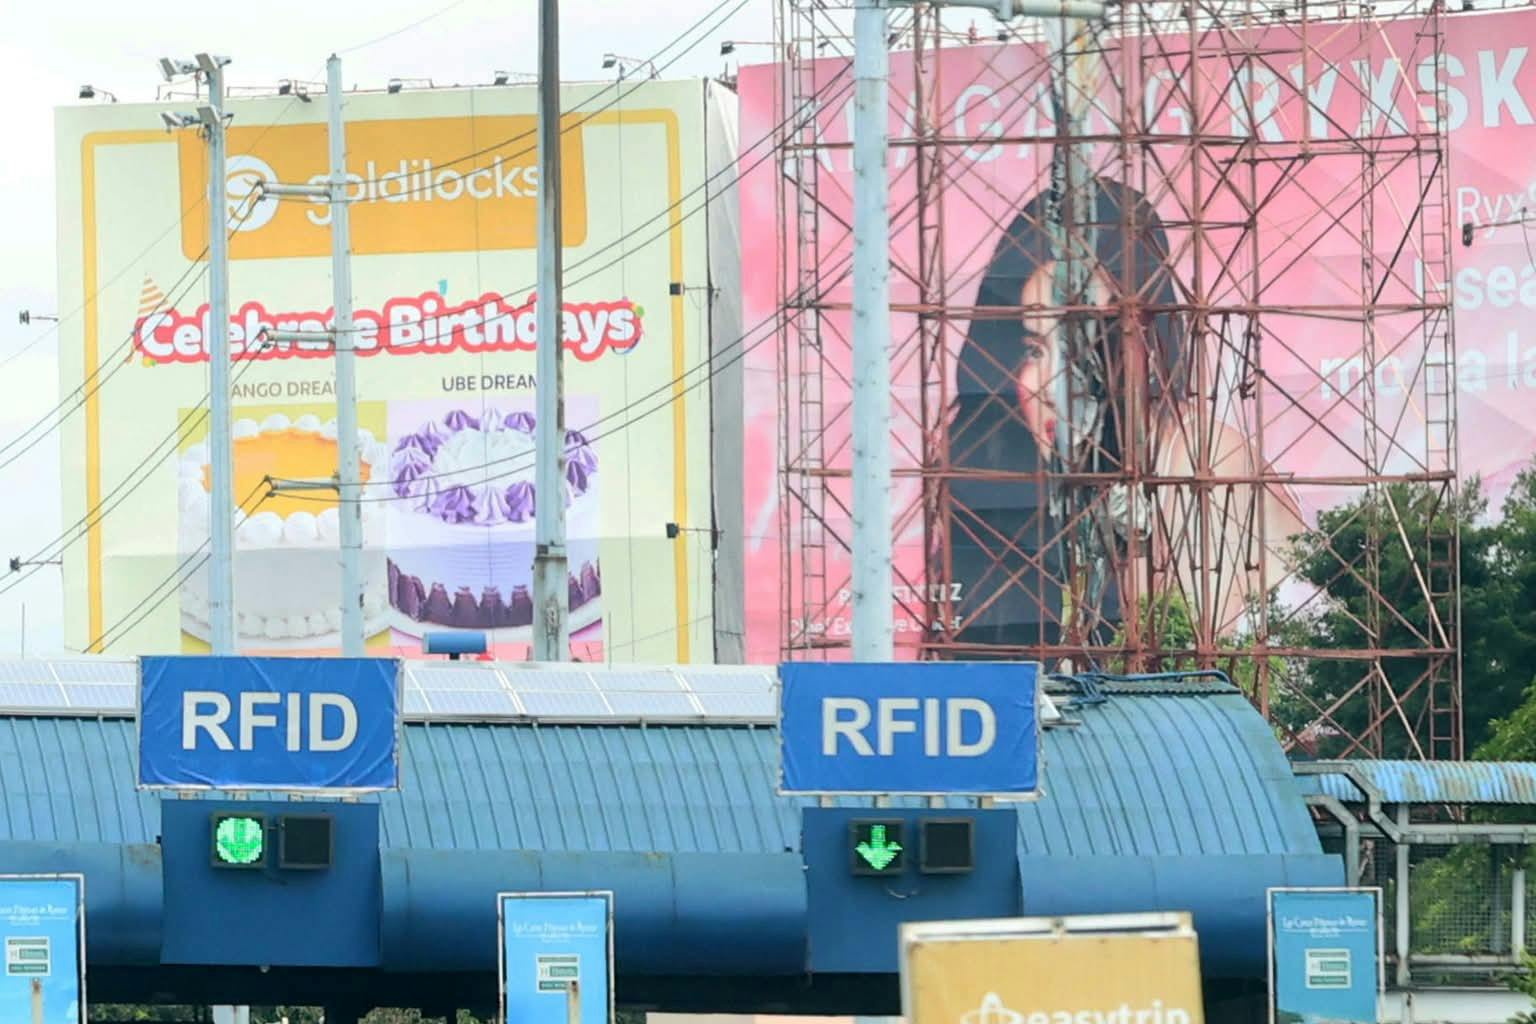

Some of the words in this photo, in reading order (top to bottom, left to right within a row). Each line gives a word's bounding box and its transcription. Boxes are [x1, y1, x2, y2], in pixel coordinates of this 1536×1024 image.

[231, 381, 282, 398] ANGO
[287, 380, 337, 396] DREA
[442, 376, 476, 391] UBE
[182, 691, 358, 752] RFID
[822, 697, 997, 757] RFID
